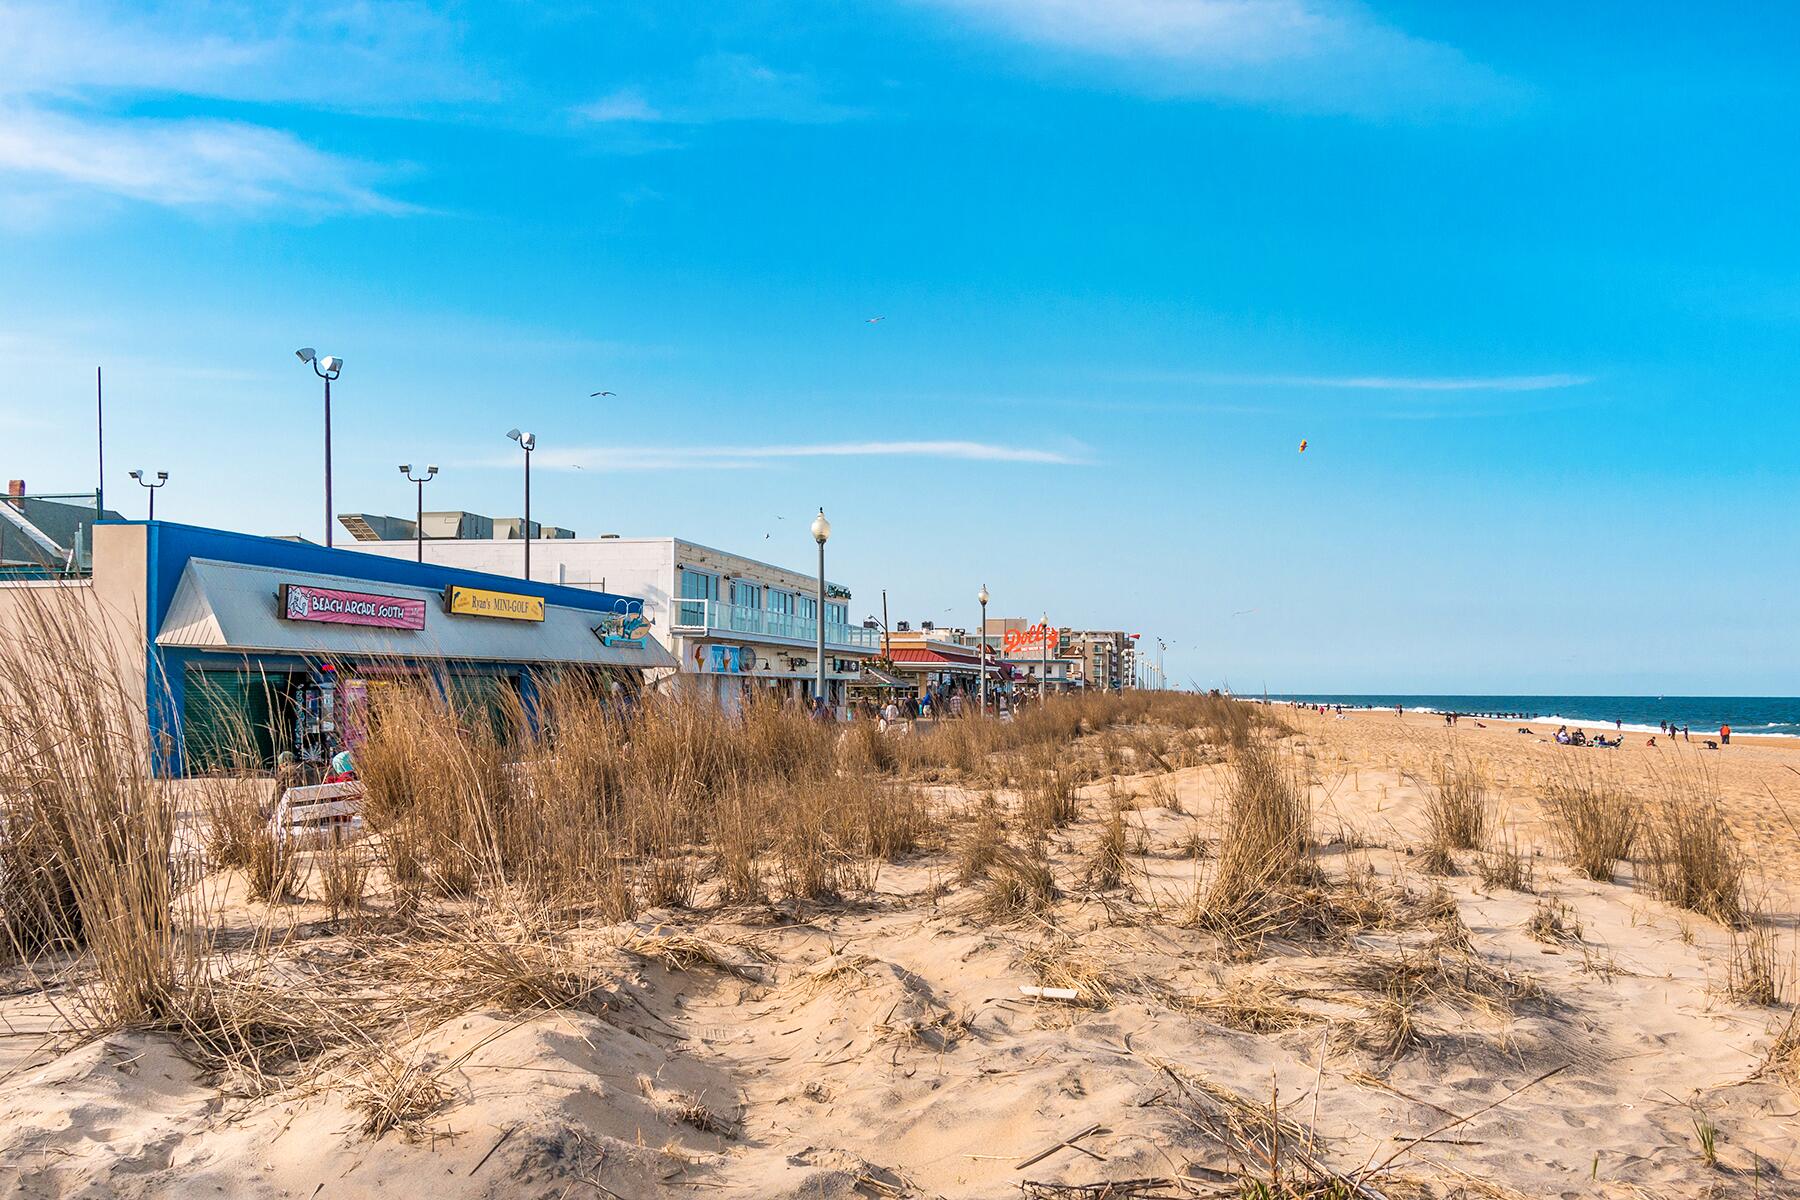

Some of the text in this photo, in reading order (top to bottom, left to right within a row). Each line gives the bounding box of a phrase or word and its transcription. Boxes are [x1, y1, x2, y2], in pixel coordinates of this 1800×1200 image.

[312, 596, 343, 612] BEACH
[344, 600, 376, 616] ARCADE
[377, 604, 405, 619] SOUTH
[471, 595, 491, 611] Ryan's
[494, 598, 529, 614] MINI-GOLF
